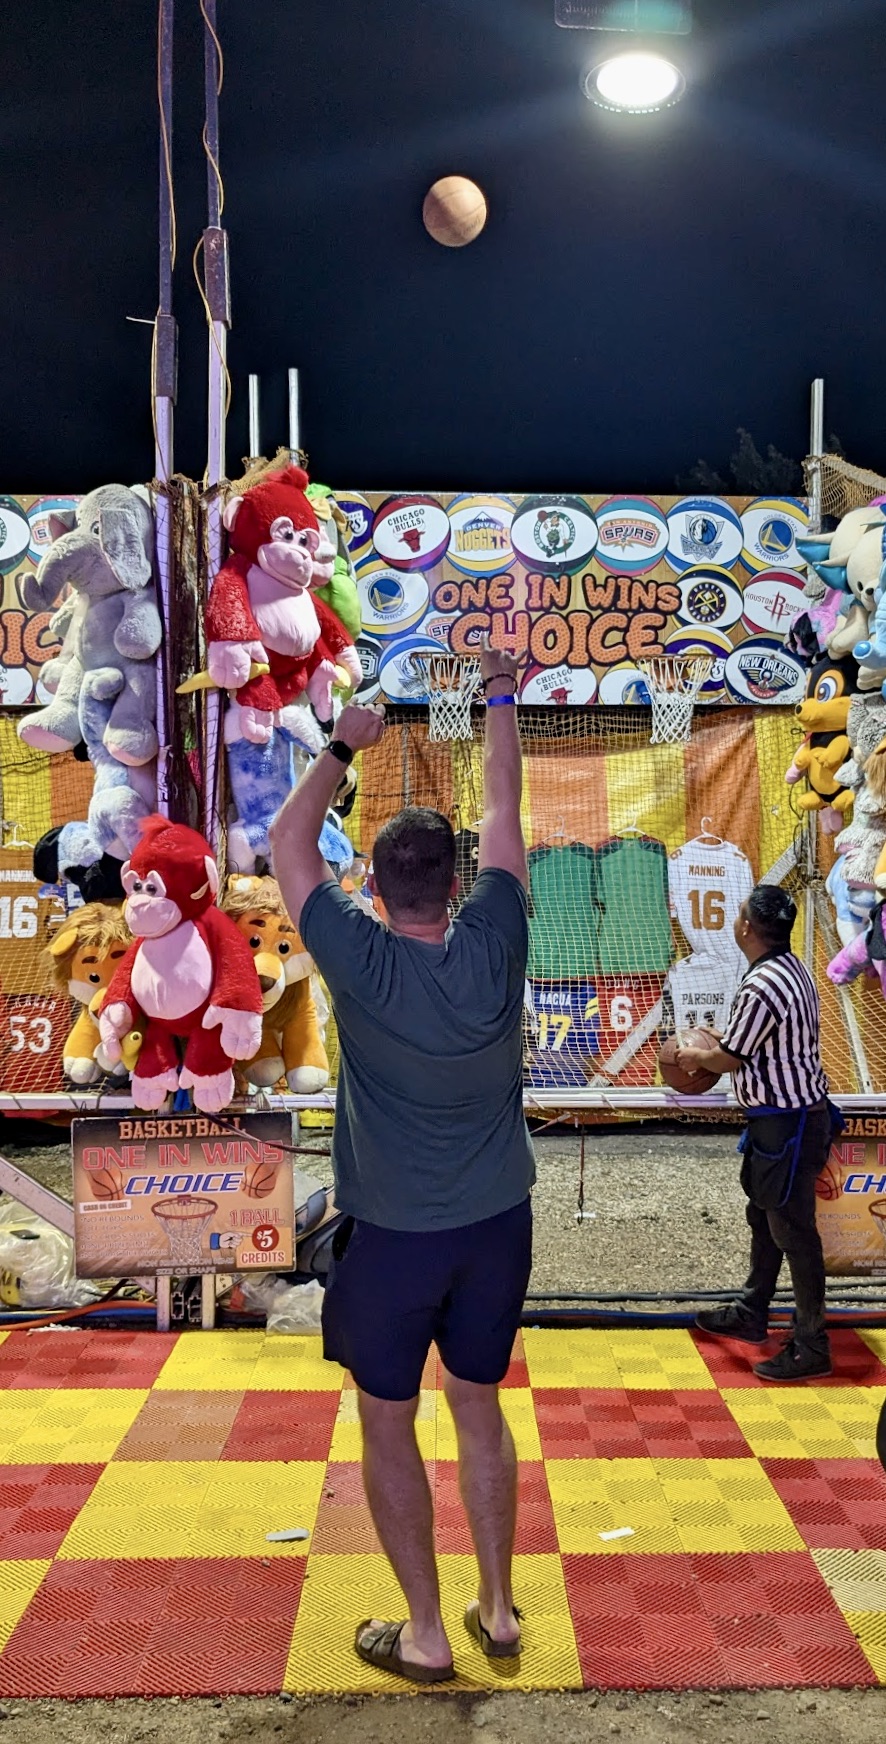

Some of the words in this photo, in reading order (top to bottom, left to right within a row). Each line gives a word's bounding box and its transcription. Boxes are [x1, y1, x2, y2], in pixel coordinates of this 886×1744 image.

[387, 508, 425, 526] CHICAGO
[395, 517, 421, 532] BULLS
[466, 522, 501, 531] DENVER
[454, 527, 511, 552] NUGGETS
[604, 526, 654, 541] SPURS
[754, 542, 789, 562] WARRIORS
[433, 574, 514, 612] ONE
[526, 574, 571, 611] IN
[582, 574, 682, 614] WINS
[745, 592, 774, 605] HOUSTON
[373, 602, 409, 621] WARRIORS
[449, 610, 667, 669] CHOICE
[536, 669, 573, 685] CHICAGO
[739, 655, 762, 668] NEW
[762, 658, 798, 685] ORLEANS
[543, 677, 569, 691] BULLS
[688, 865, 725, 877] MANNING
[0, 896, 38, 938] 16
[687, 889, 726, 930] 16
[681, 993, 725, 1005] PARSONS
[611, 996, 632, 1030] 6
[10, 1016, 52, 1053] 53
[539, 1013, 571, 1051] 17
[119, 1117, 246, 1140] BASKETBALL
[82, 1145, 147, 1171] ONE
[158, 1143, 191, 1168] IN
[201, 1140, 285, 1166] WINS
[124, 1171, 244, 1197] CHOICE
[230, 1210, 238, 1227] 1
[241, 1208, 285, 1226] BALL
[257, 1229, 274, 1248] $5
[241, 1251, 285, 1264] CREDITS
